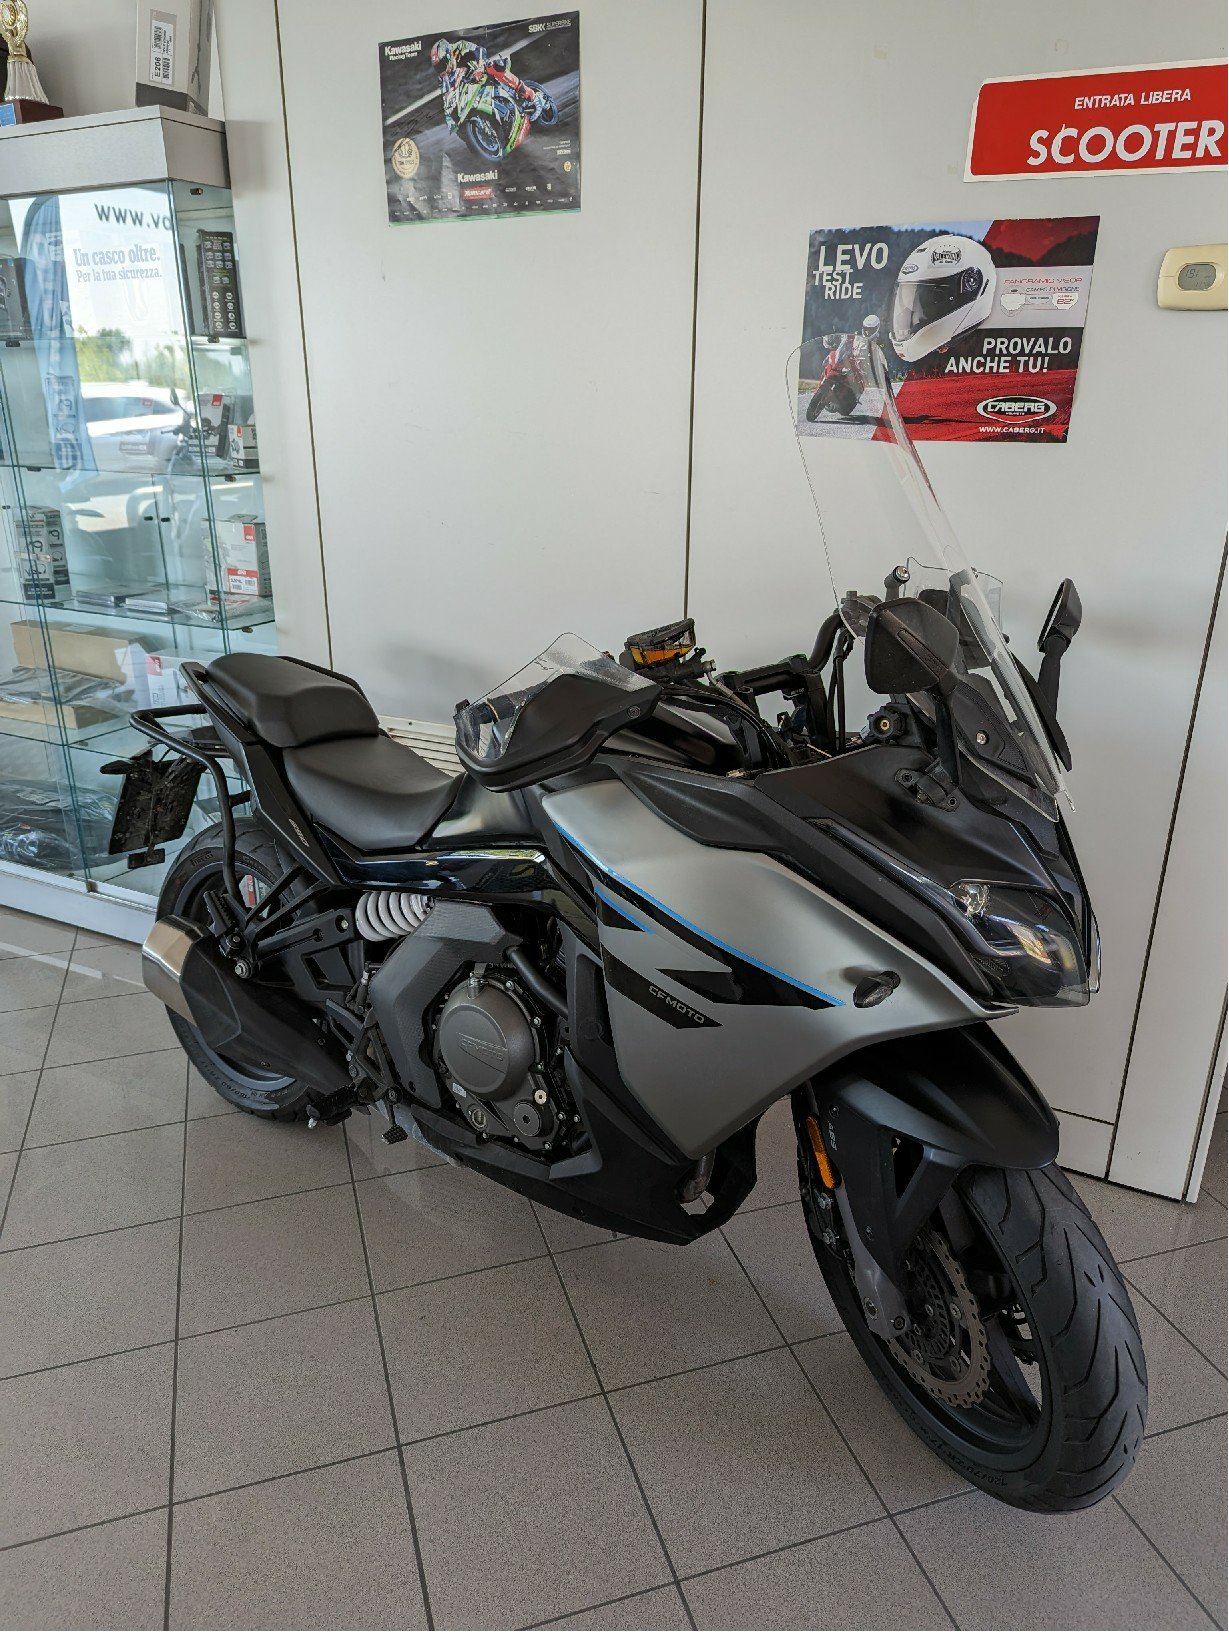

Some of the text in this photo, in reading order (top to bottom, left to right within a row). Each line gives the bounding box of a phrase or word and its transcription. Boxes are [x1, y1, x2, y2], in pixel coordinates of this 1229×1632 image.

[384, 40, 422, 56] Kawasaki
[1074, 88, 1192, 110] ENTRATA LIBERA
[1026, 119, 1225, 167] SCOOTER
[457, 169, 498, 183] Kawasaki
[72, 243, 161, 267] Un casco oltre.
[818, 242, 889, 273] LEVO
[75, 266, 162, 283] Per la tua sicurezza.
[812, 268, 853, 286] TEST
[824, 282, 864, 300] RIDE
[982, 336, 1072, 356] PROVALO
[944, 355, 1050, 374] ANCHE TU!
[987, 401, 1046, 413] CABERG
[979, 426, 1046, 434] WWW.CABERG.IT
[649, 985, 705, 1024] CFMOTO
